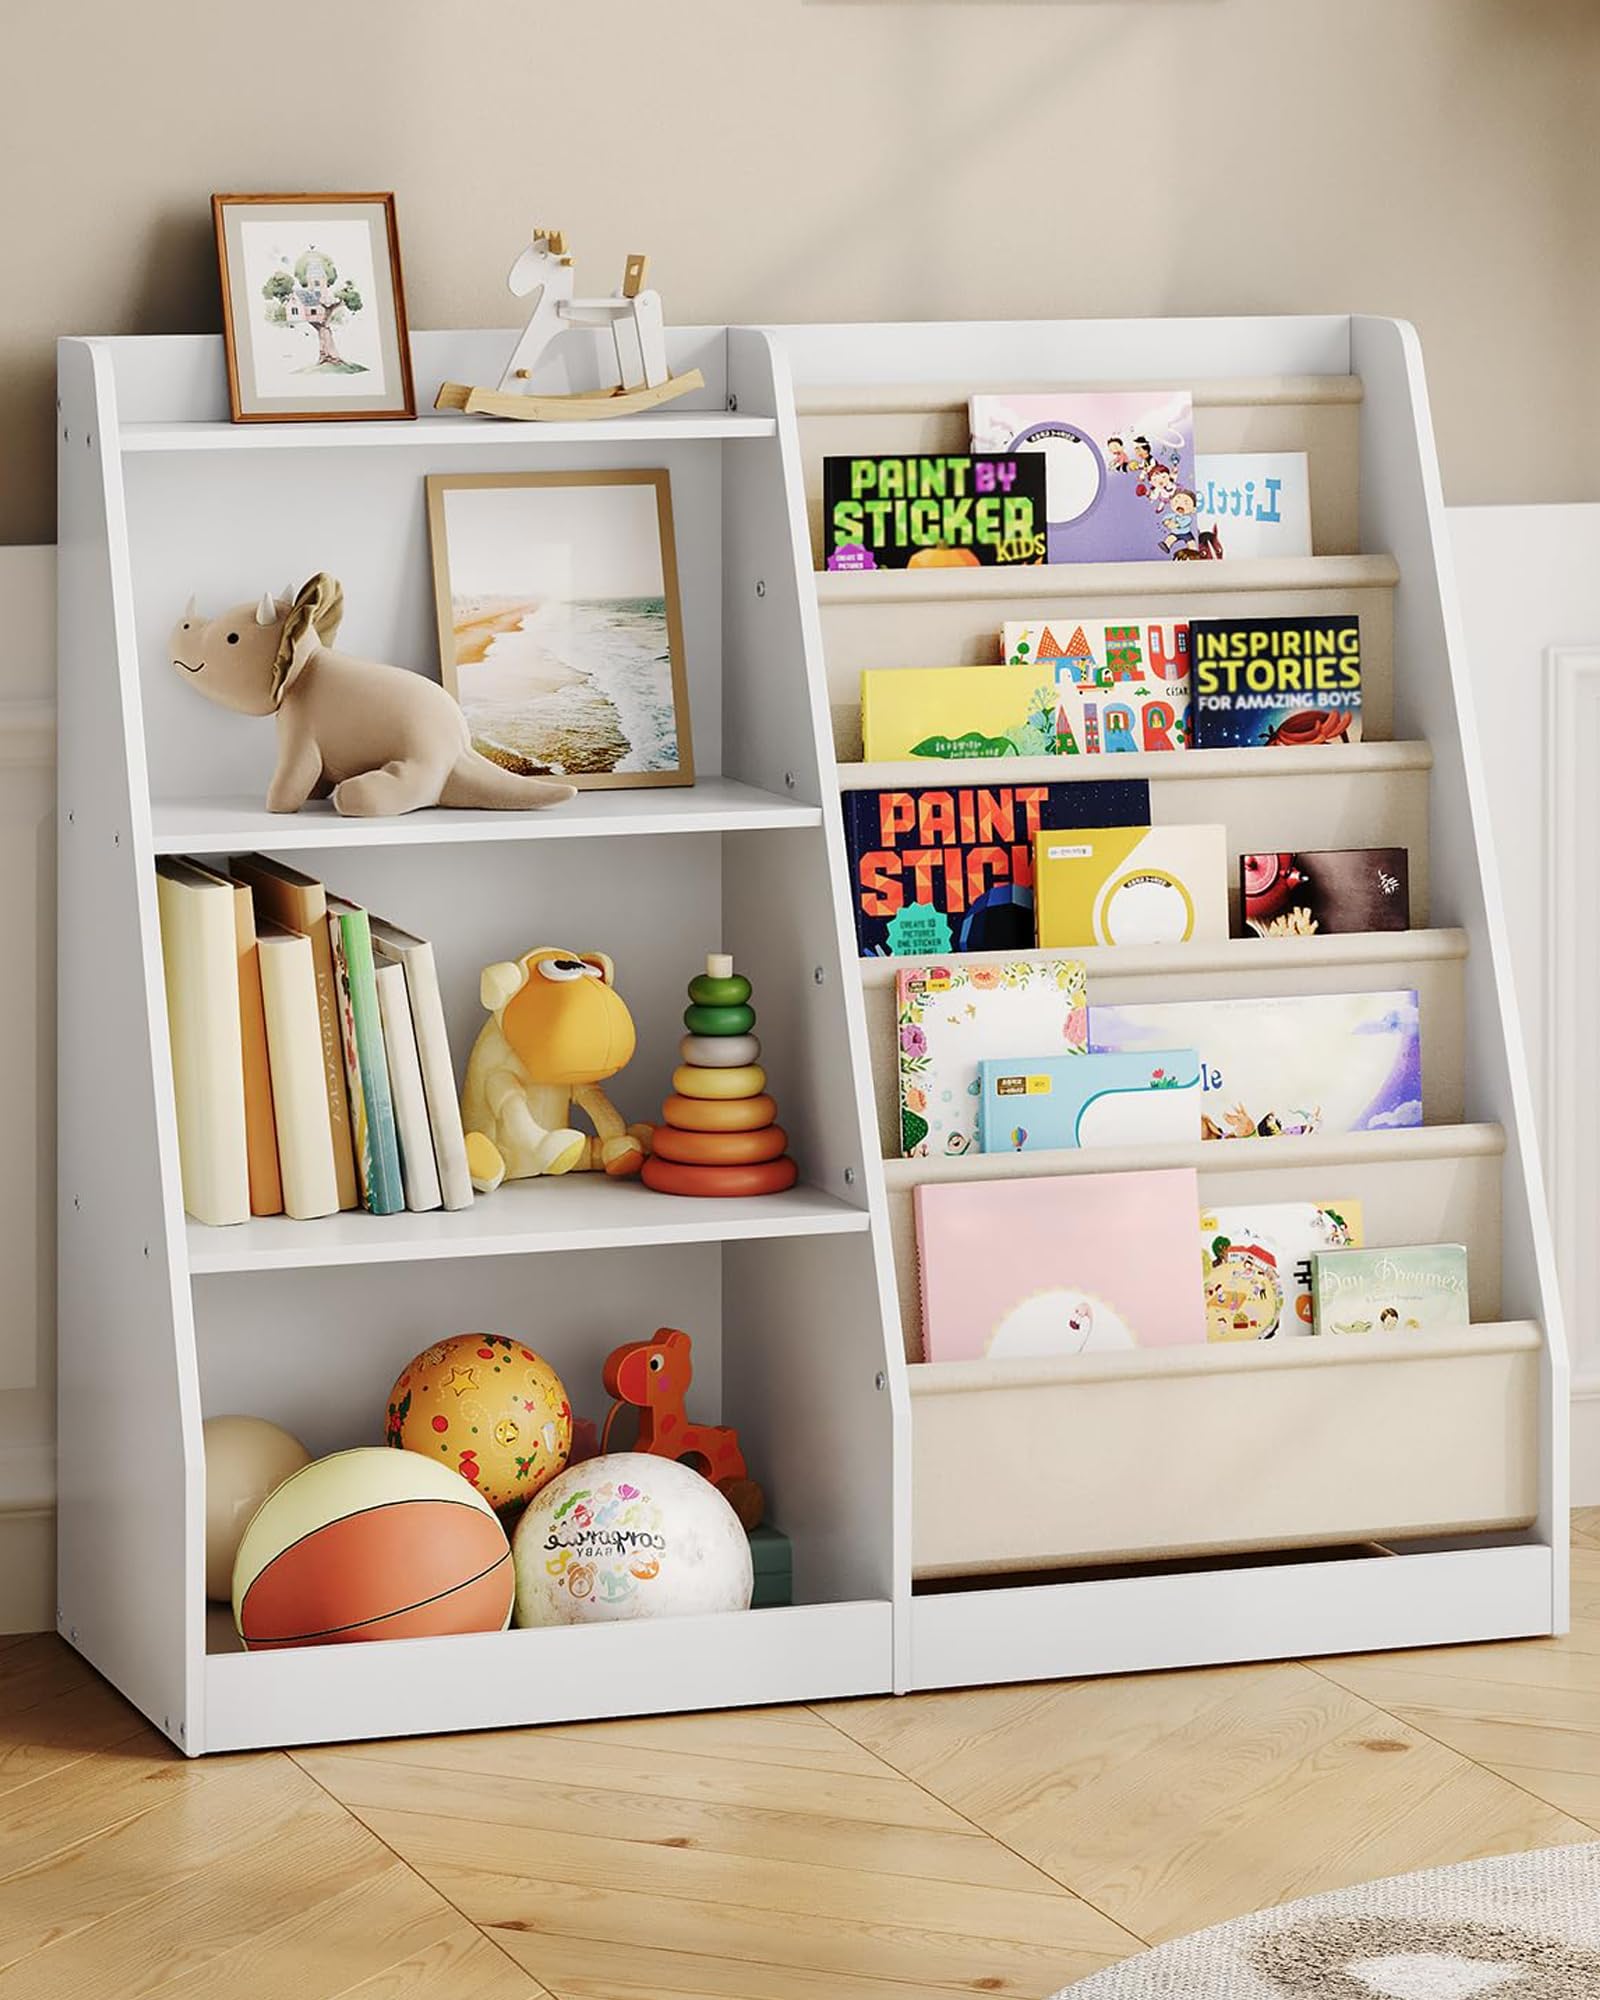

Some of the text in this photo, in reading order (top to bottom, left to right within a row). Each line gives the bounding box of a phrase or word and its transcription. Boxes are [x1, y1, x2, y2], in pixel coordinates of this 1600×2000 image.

[851, 458, 1017, 499] PAINT BY
[833, 496, 1035, 547] STICKER
[996, 532, 1046, 562] KIDS
[1197, 628, 1359, 658] INSPIRING
[1197, 656, 1361, 693] STORIES
[1198, 690, 1362, 712] FOR AMAZING BOYS
[878, 787, 1049, 847] PAINT
[900, 920, 925, 929] CREATE
[913, 938, 941, 947] STICKER
